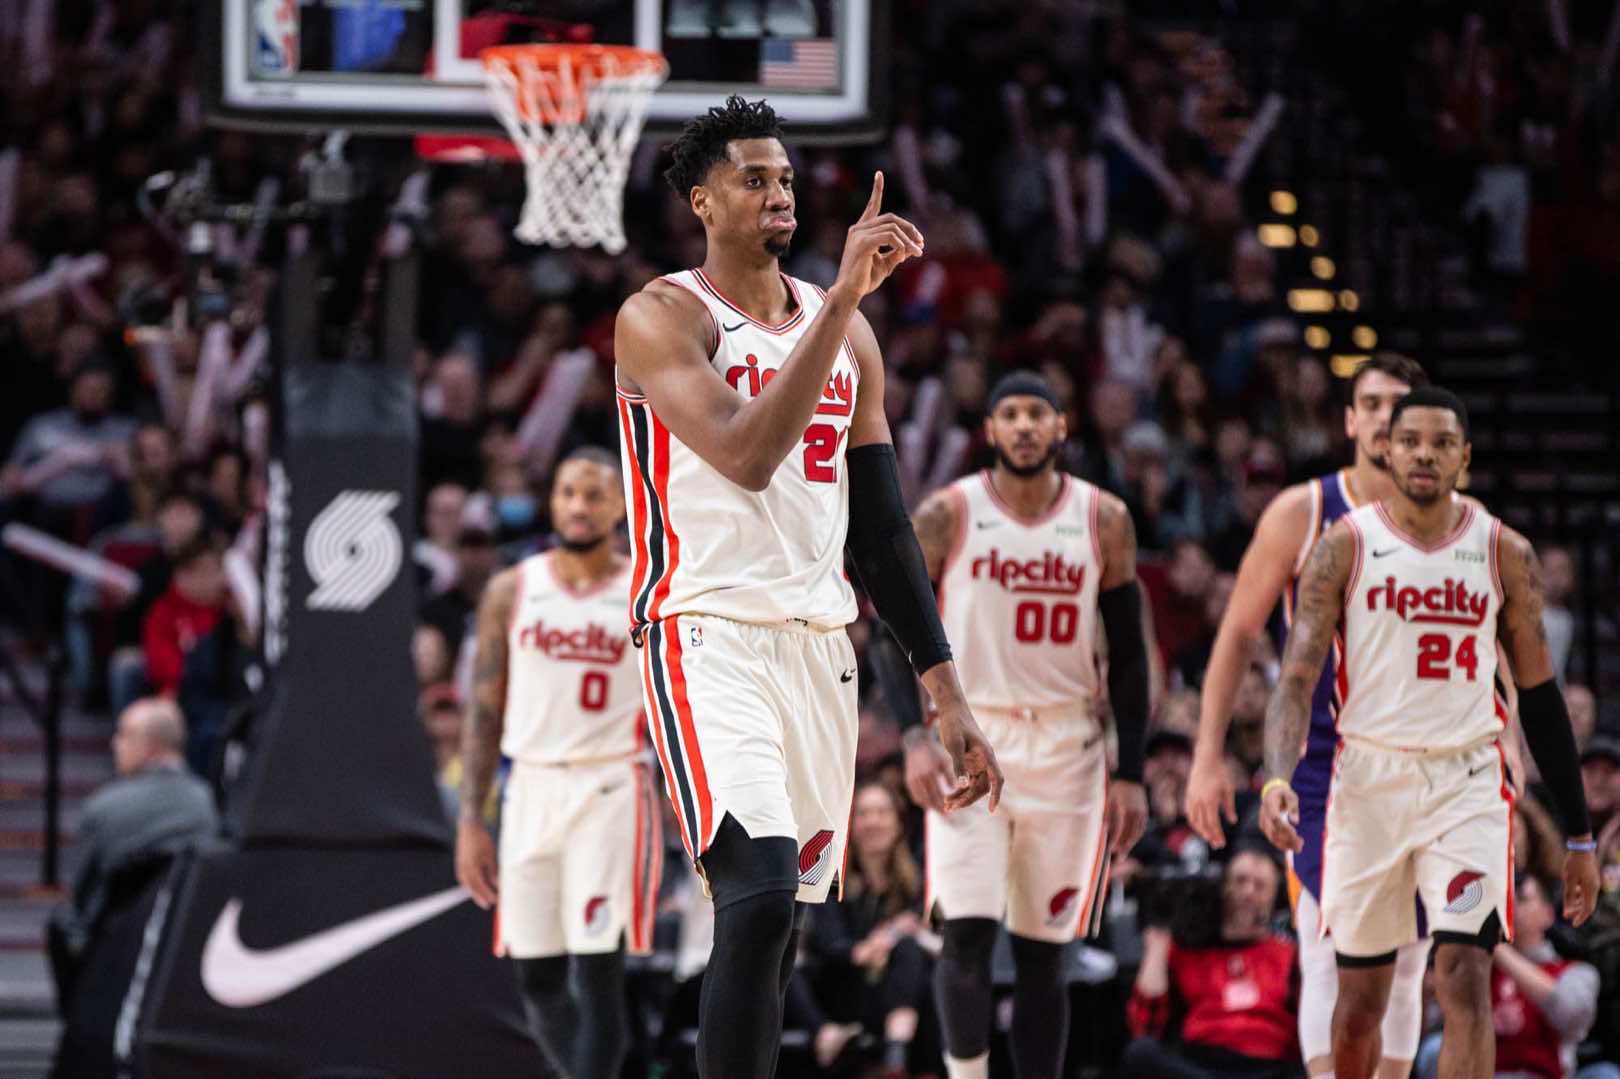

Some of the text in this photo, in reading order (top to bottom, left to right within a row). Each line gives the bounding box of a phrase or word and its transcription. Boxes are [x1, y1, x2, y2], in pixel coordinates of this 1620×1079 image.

[803, 424, 848, 483] 2
[970, 547, 1085, 595] ripcity
[1016, 601, 1079, 645] 00
[1367, 576, 1489, 627] ripcity
[519, 619, 627, 665] ripcity
[1417, 632, 1478, 682] 24
[580, 671, 609, 712] 0
